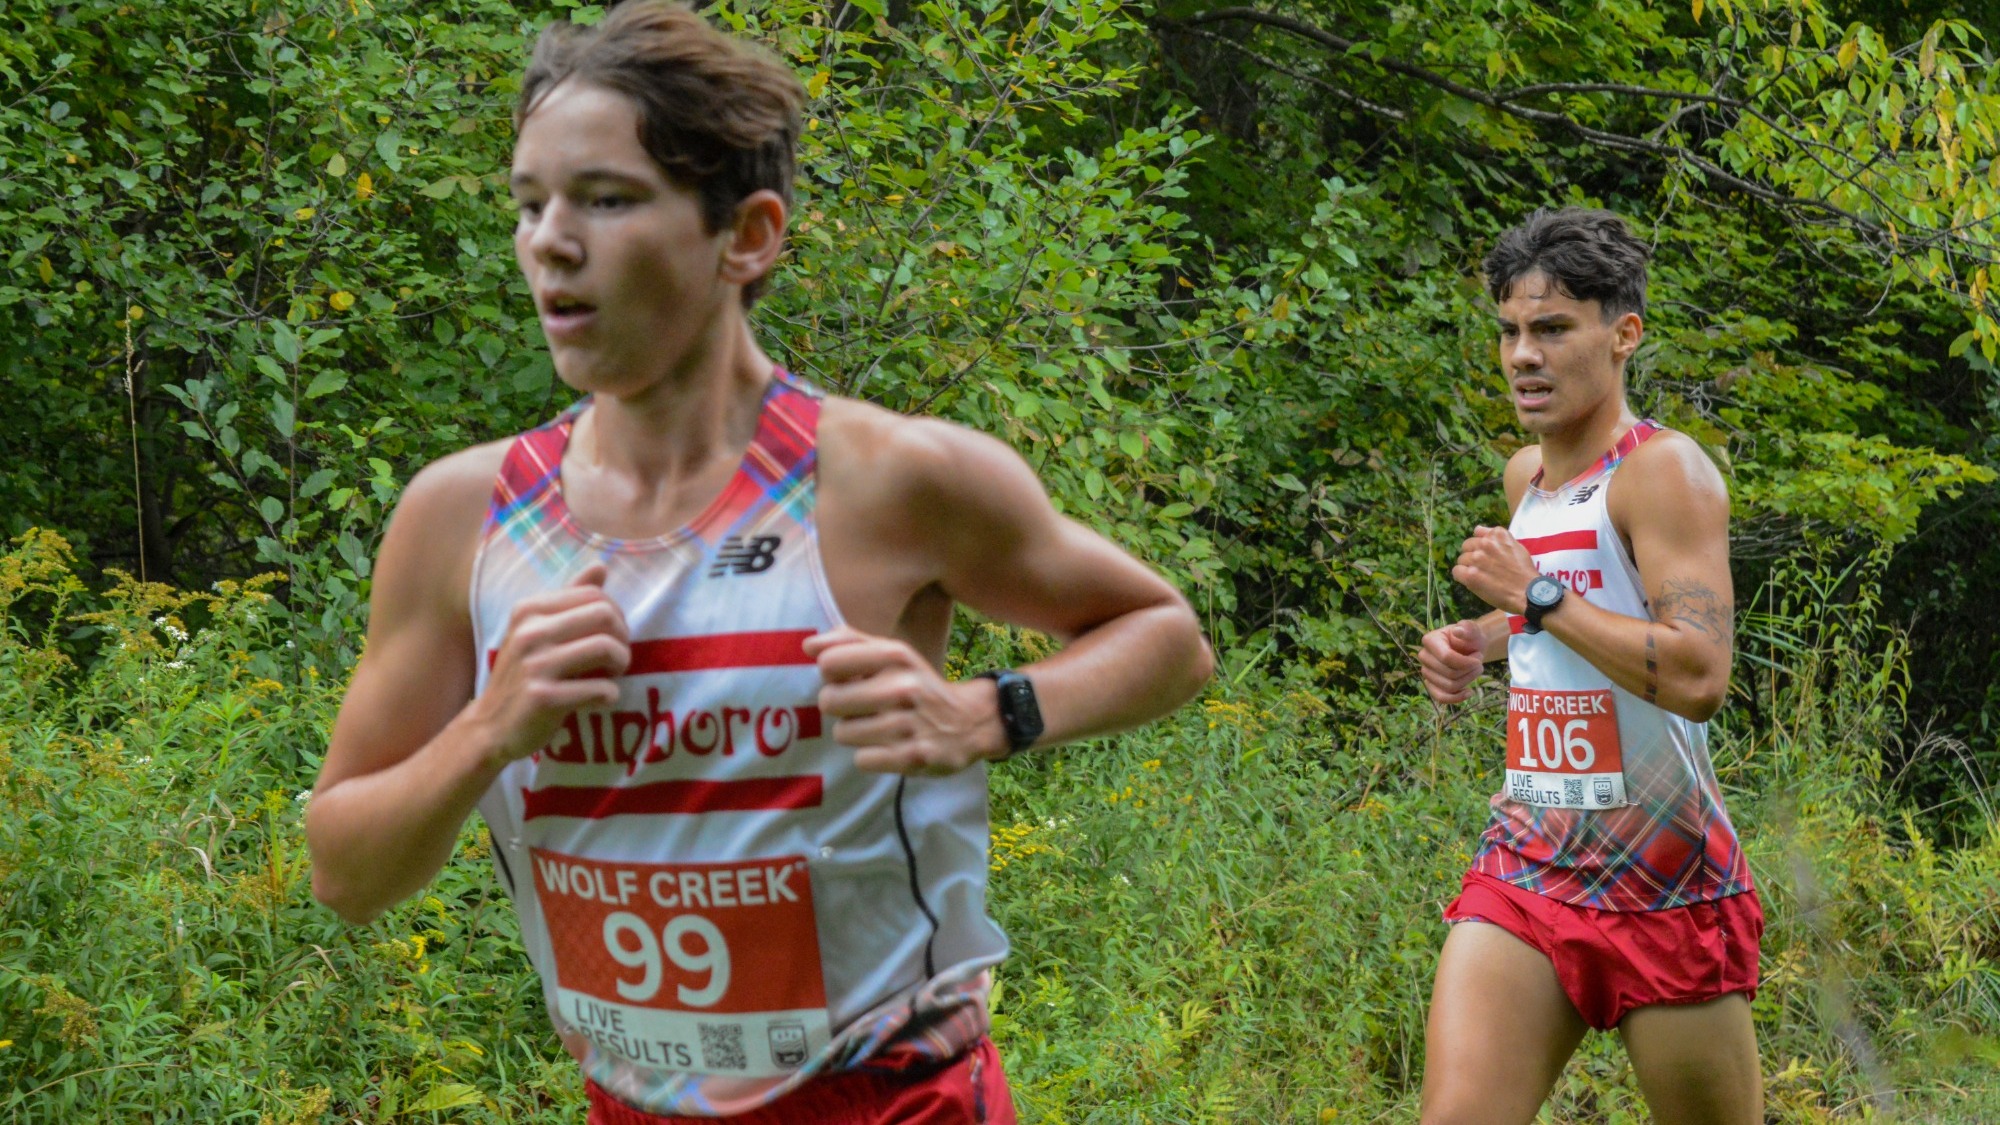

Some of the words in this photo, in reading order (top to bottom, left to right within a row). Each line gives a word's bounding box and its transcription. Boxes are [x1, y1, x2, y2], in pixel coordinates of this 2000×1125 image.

[1510, 692, 1540, 714] WOLF
[1543, 694, 1608, 715] CREEK
[1517, 717, 1596, 771] 106
[1511, 773, 1533, 789] LIVE
[1512, 788, 1561, 805] RESULTS
[537, 856, 640, 906] WOLF
[649, 864, 798, 909] CREEK
[602, 911, 732, 1008] 99
[575, 998, 626, 1034] LIVE
[580, 1025, 692, 1067] RESULTS
